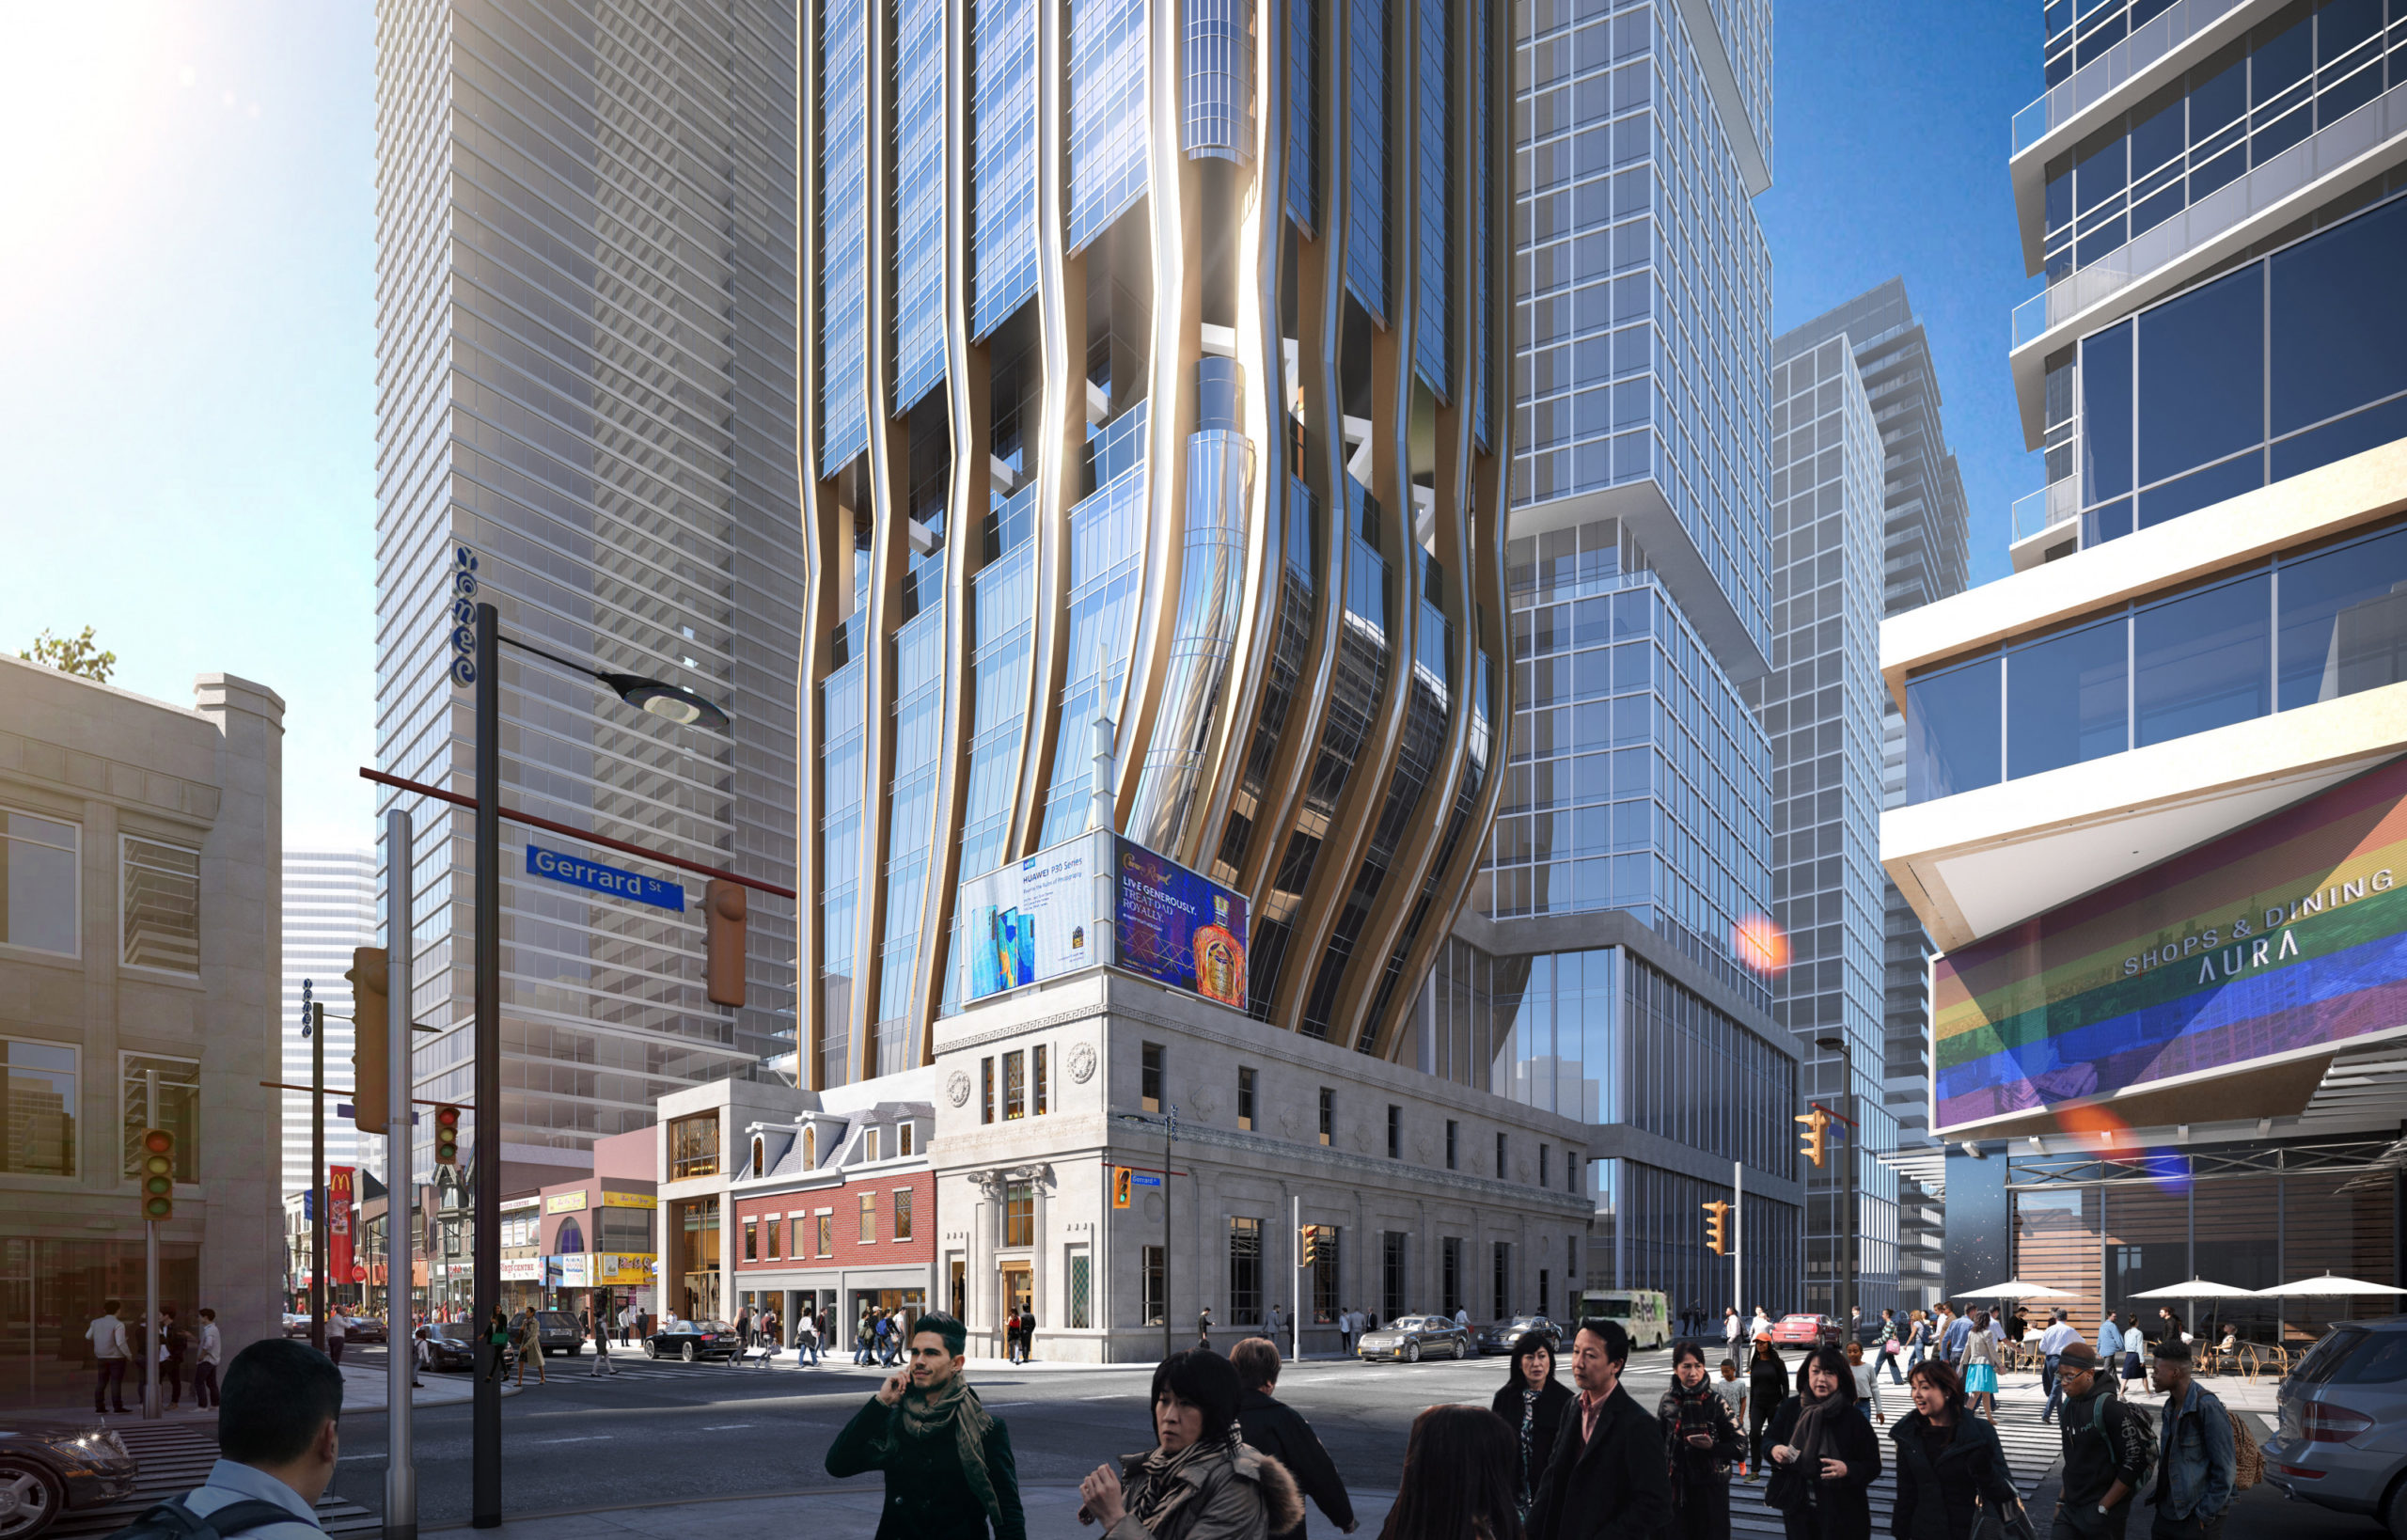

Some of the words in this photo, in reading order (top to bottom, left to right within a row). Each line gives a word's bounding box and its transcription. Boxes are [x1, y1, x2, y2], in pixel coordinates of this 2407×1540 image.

[534, 851, 642, 896] Gerrard
[648, 880, 662, 893] St
[1023, 868, 1049, 885] HUAWEI
[1051, 863, 1063, 874] P30
[1063, 857, 1083, 871] Series
[1123, 875, 1142, 891] LIVE
[1142, 885, 1197, 916] GENEROUSLY.
[1123, 886, 1154, 907] TREAT
[1154, 899, 1173, 916] DAD
[1123, 897, 1165, 923] ROYALLY.
[2123, 928, 2219, 976] SHOPS
[2232, 919, 2252, 939] &
[2264, 869, 2394, 930] DINING
[2197, 929, 2300, 985] AURA
[513, 1263, 534, 1271] CENTRE
